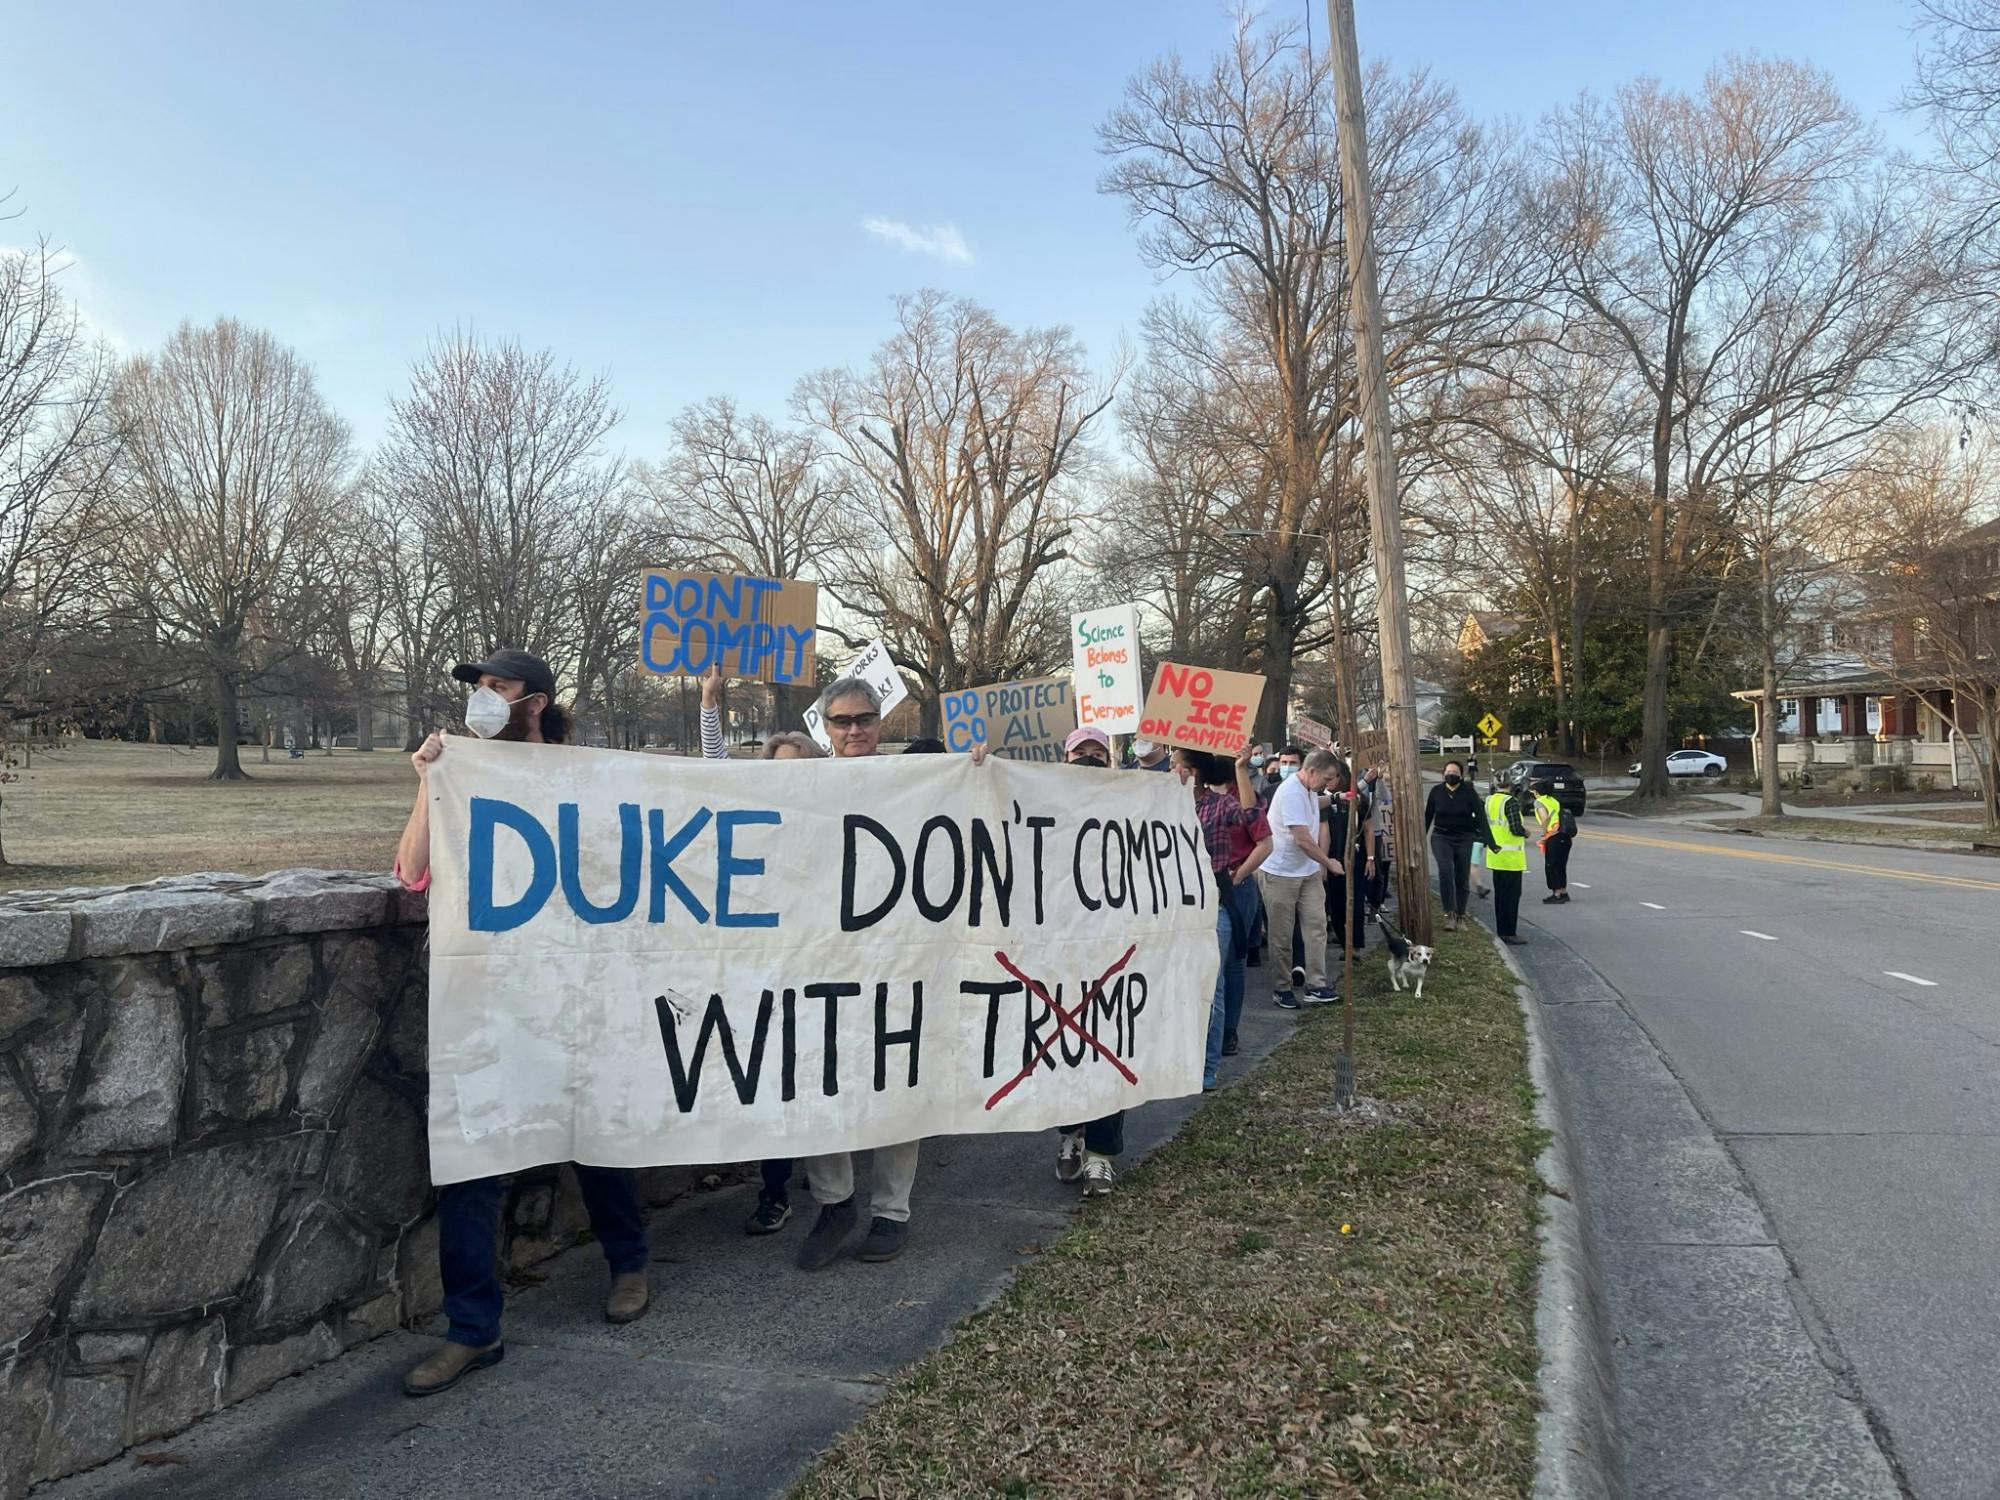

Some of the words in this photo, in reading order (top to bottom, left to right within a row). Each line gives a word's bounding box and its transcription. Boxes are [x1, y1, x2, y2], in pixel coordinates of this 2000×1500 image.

[645, 575, 783, 621] DONT
[642, 611, 814, 683] COMPLY
[1078, 618, 1126, 647] Science
[1087, 646, 1128, 667] Belongs
[1097, 668, 1115, 688] to
[1157, 664, 1213, 698] NO
[944, 690, 979, 720] DO
[985, 681, 1068, 718] PROTECT
[1080, 695, 1135, 723] Everyone
[1186, 699, 1247, 731] ICE
[1003, 712, 1051, 745] ALL
[1140, 719, 1172, 737] ON
[1174, 724, 1246, 751] CAMPUS
[468, 797, 782, 933] DUKE
[840, 800, 1055, 932] DON'T
[1072, 817, 1204, 914] COMPLY
[655, 981, 922, 1112] WITH
[960, 973, 1147, 1078] TRUMP
